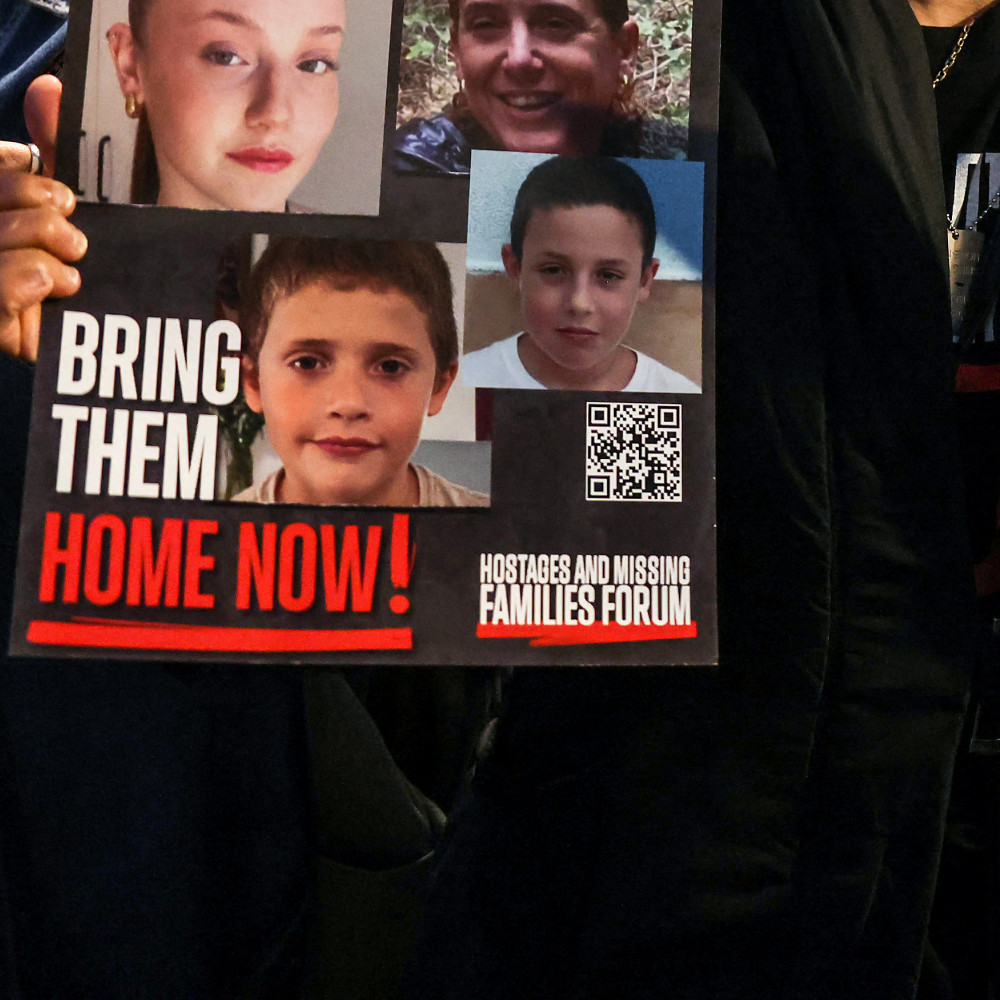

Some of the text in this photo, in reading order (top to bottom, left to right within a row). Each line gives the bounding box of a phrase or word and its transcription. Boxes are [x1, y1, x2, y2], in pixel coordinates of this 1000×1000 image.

[56, 310, 242, 406] BRING
[51, 403, 219, 501] THEM
[38, 511, 416, 615] HOME NOW!
[479, 553, 691, 585] HOSTAGES AND MISSING
[479, 583, 692, 626] FAMILIES FORUM
